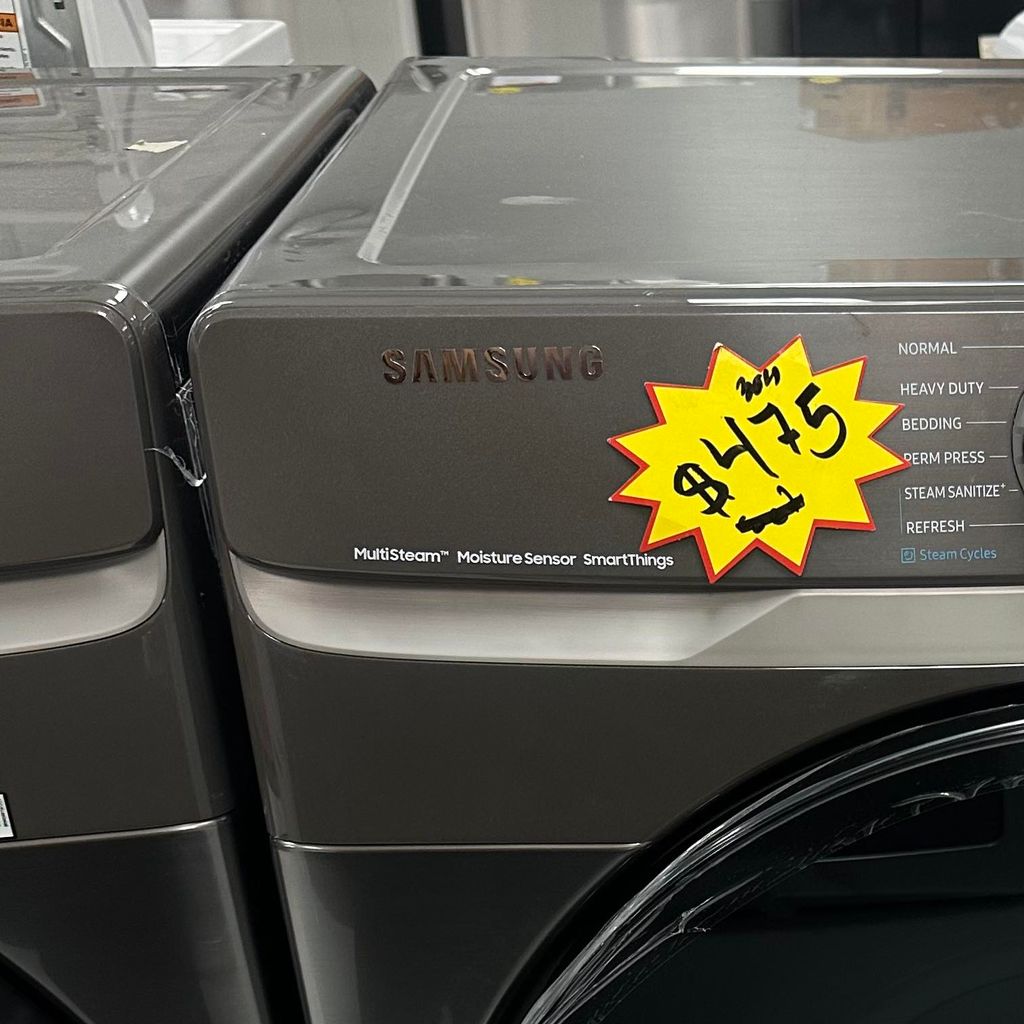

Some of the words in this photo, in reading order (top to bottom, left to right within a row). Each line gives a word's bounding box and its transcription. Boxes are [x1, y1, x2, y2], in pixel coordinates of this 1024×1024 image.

[898, 342, 958, 355] NORMAL
[382, 346, 604, 384] SAMSUNG
[900, 383, 945, 396] HEAVY
[948, 381, 984, 395] DUTY
[902, 417, 962, 431] BEDDING
[673, 382, 847, 518] $475
[903, 452, 941, 465] PERM
[944, 450, 985, 465] PRESS
[904, 486, 946, 500] STEAM
[906, 520, 965, 534] REFRESH
[456, 550, 523, 566] Moisture
[524, 552, 577, 567] Sensor
[583, 553, 675, 571] SmartThings
[919, 548, 957, 561] Steam
[959, 547, 998, 562] Cycles
